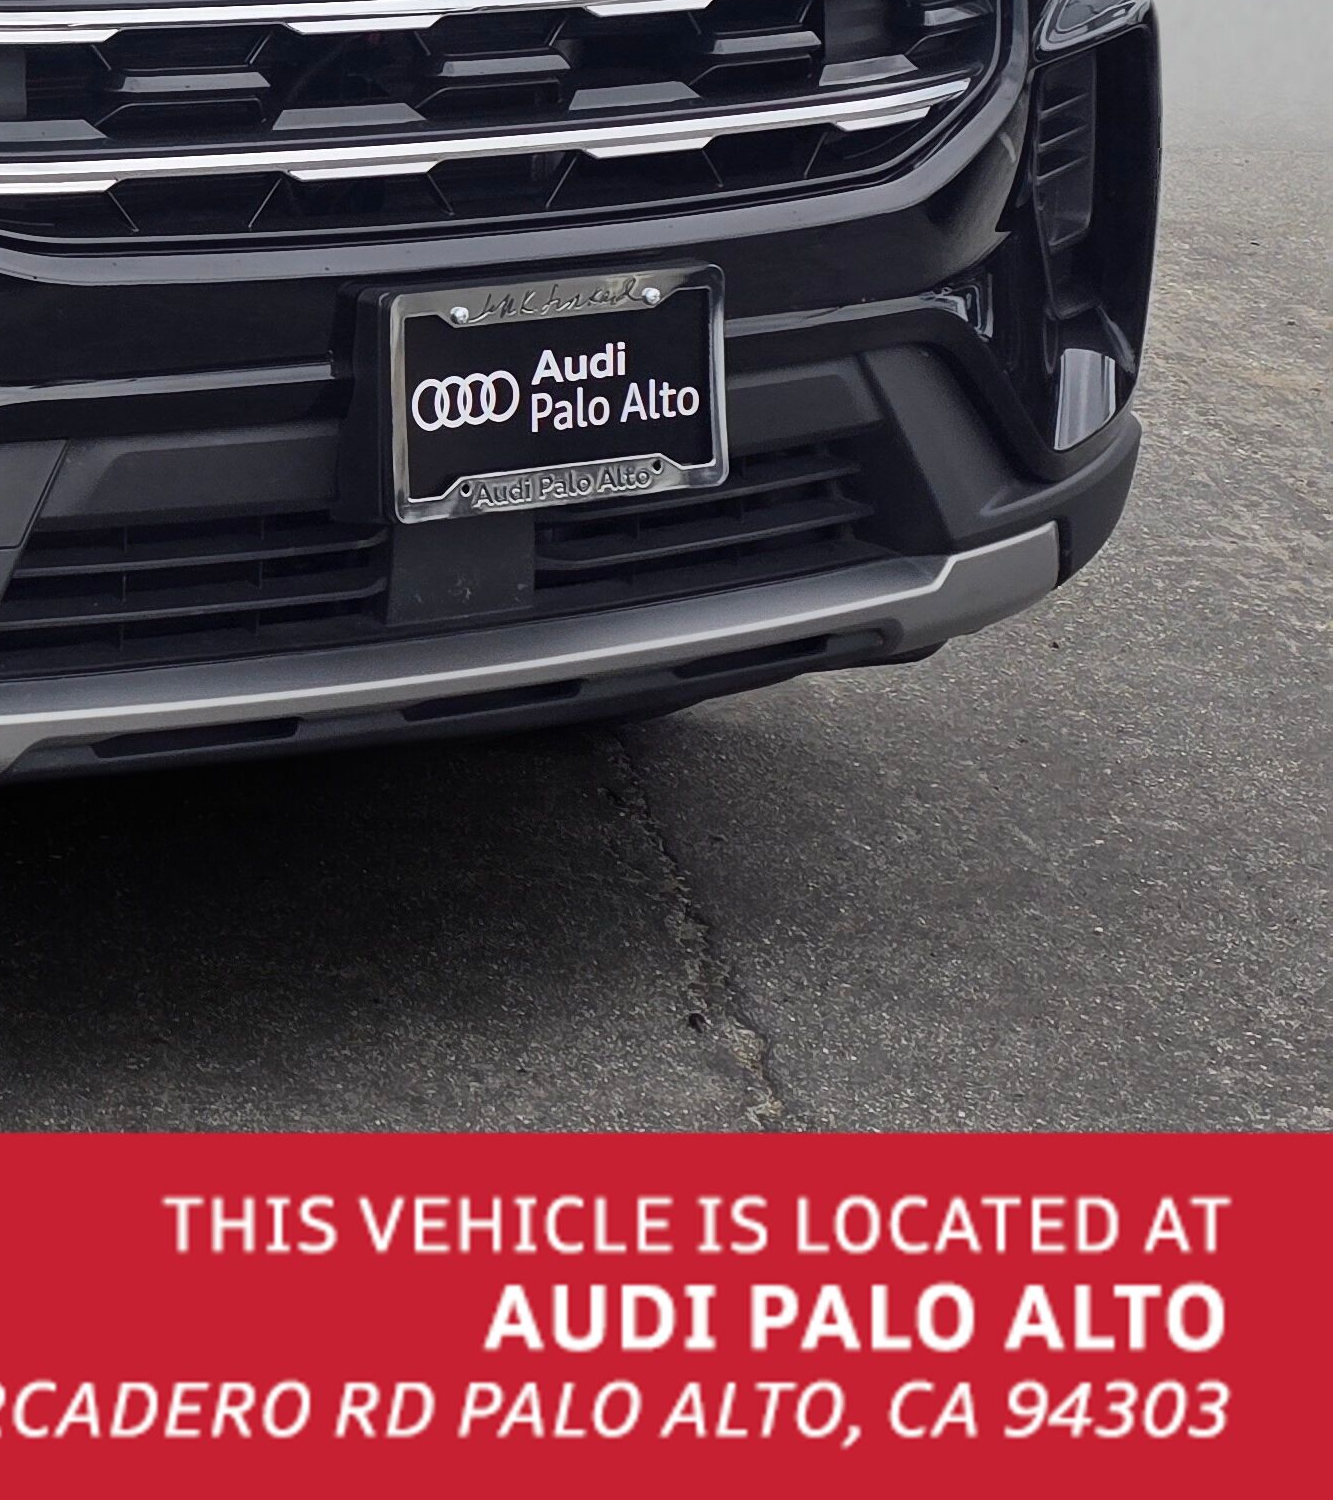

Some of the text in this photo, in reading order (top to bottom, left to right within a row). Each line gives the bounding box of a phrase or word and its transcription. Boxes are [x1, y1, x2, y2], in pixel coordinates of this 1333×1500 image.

[531, 341, 626, 386] Audi
[531, 378, 700, 433] Palo Alto
[473, 464, 652, 508] Audi Palo Alto
